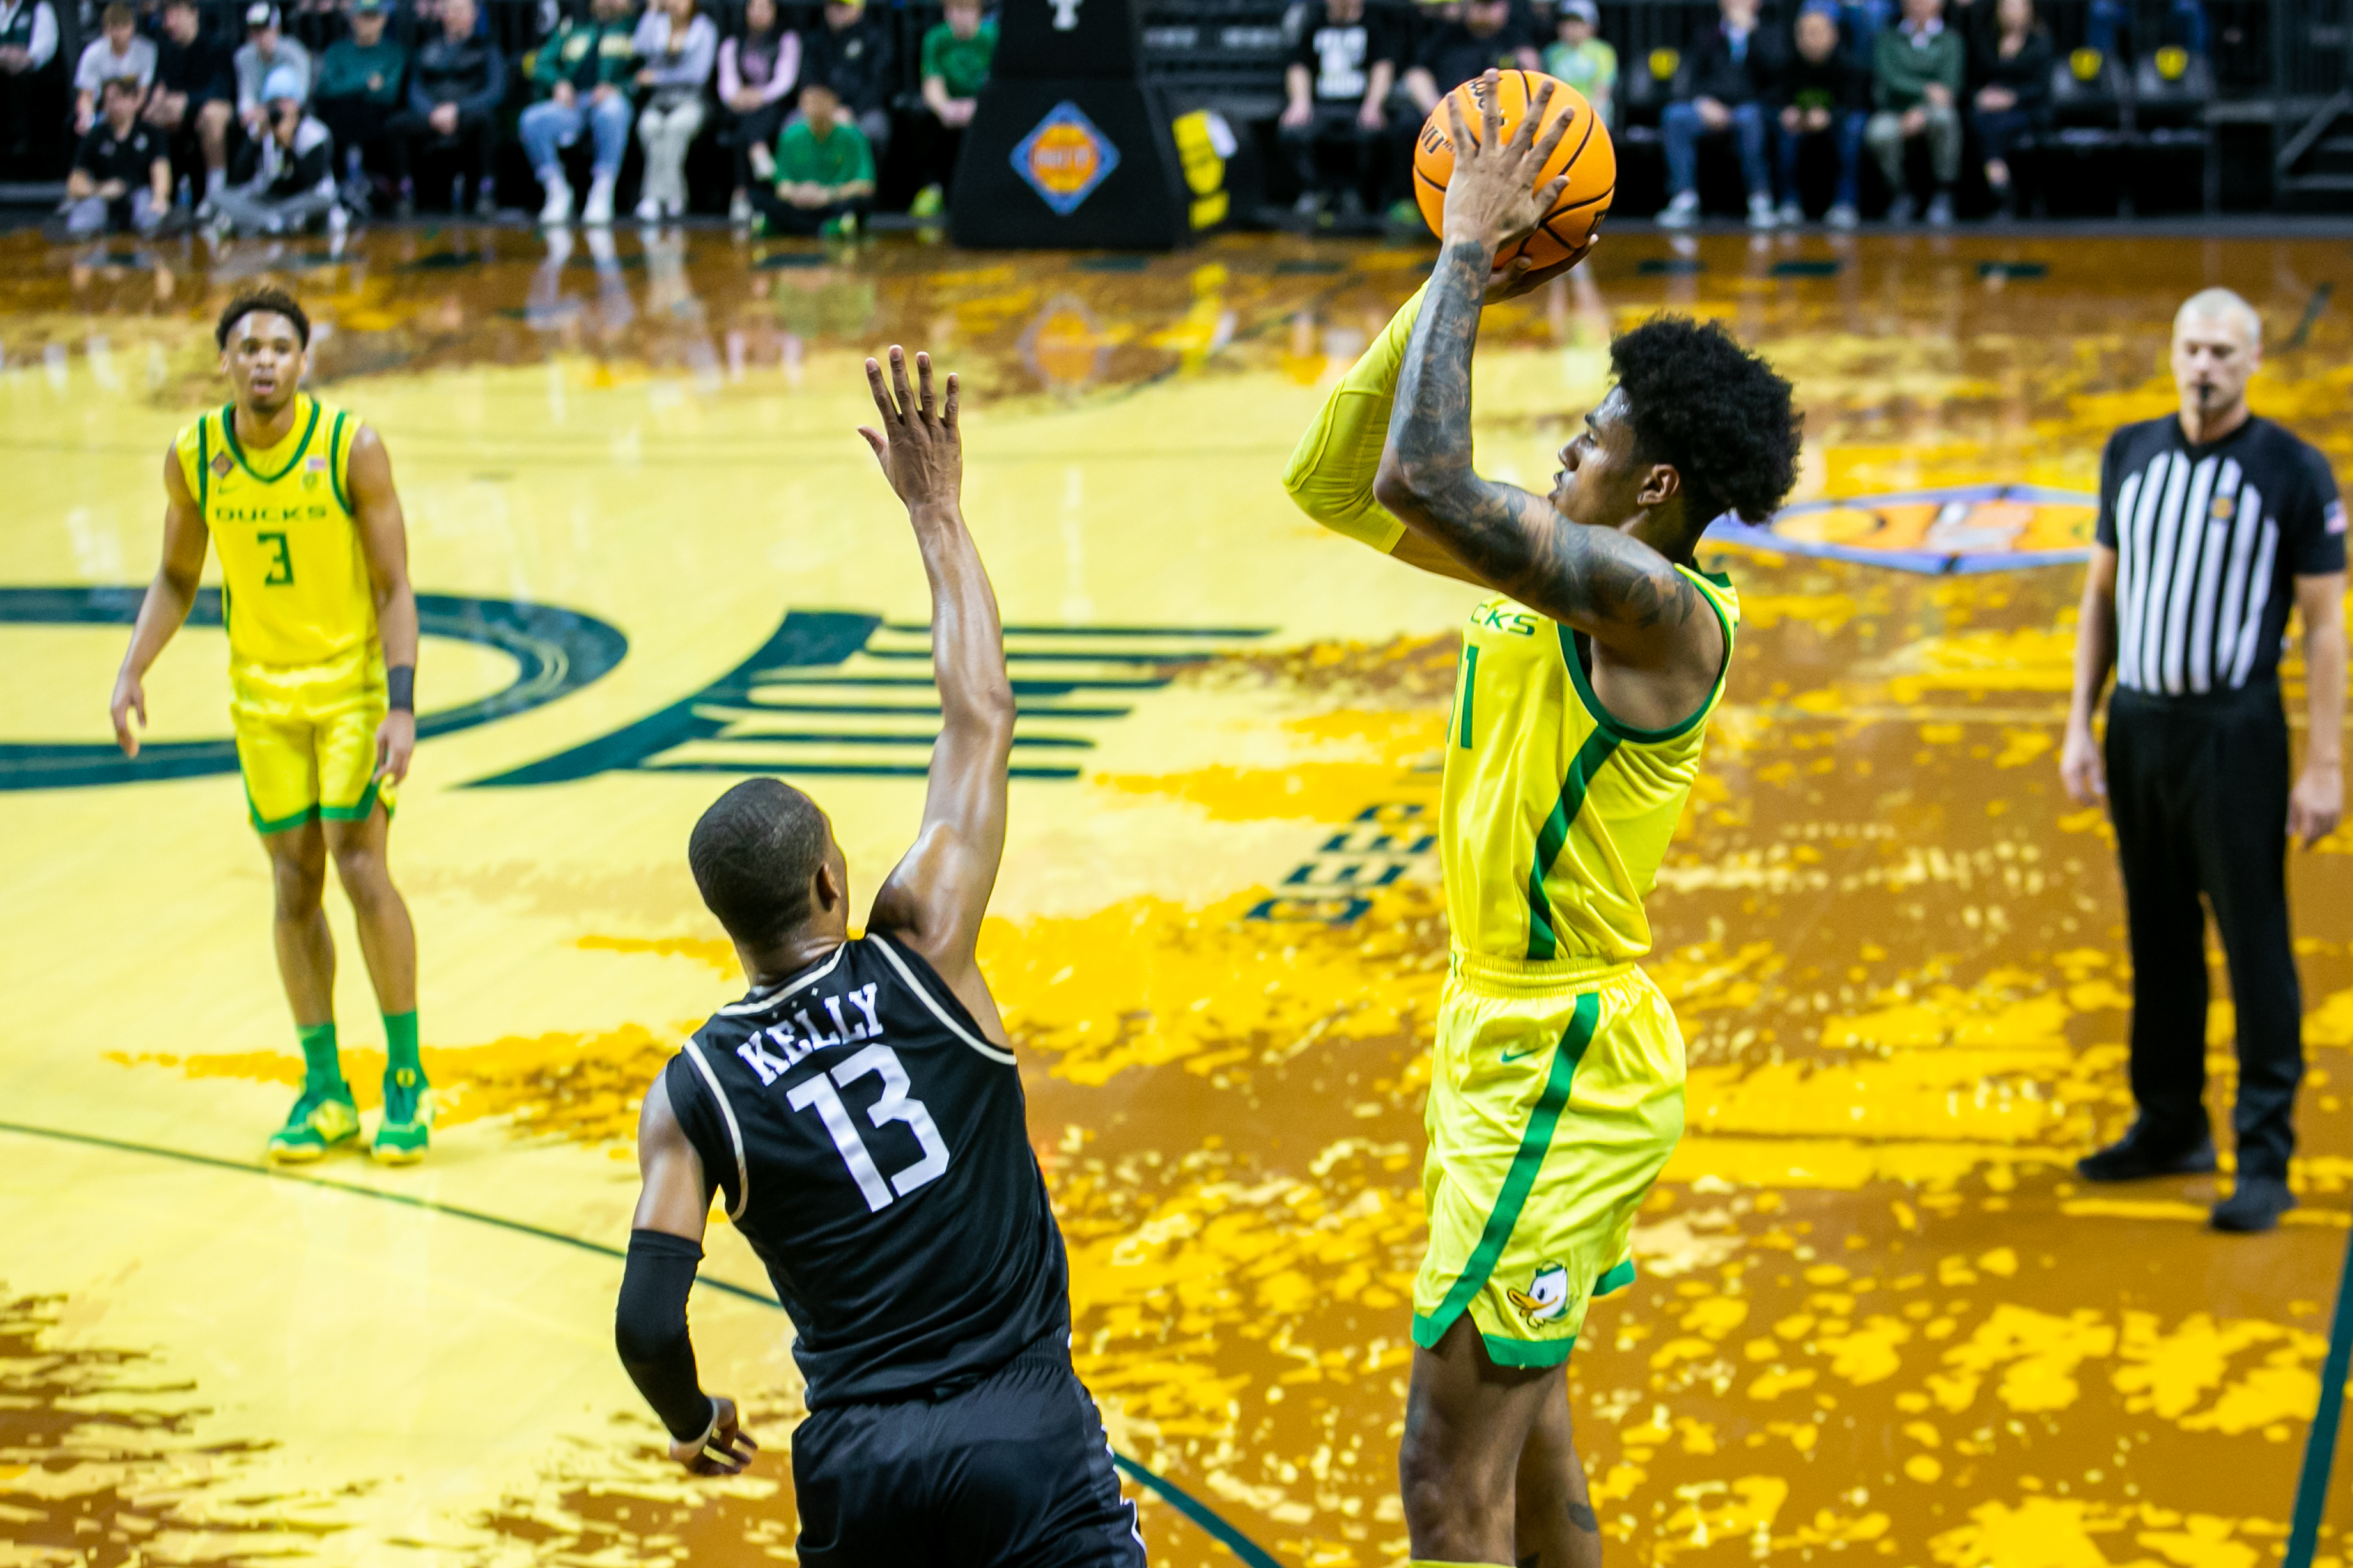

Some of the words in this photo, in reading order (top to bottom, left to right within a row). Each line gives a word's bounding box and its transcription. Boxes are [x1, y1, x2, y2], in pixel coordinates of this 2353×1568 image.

[214, 504, 328, 522] DUCKS
[256, 531, 294, 587] 3
[1470, 602, 1539, 637] CKS
[1451, 643, 1480, 749] 1
[736, 982, 885, 1087] KELLY
[786, 1042, 950, 1213] 13
